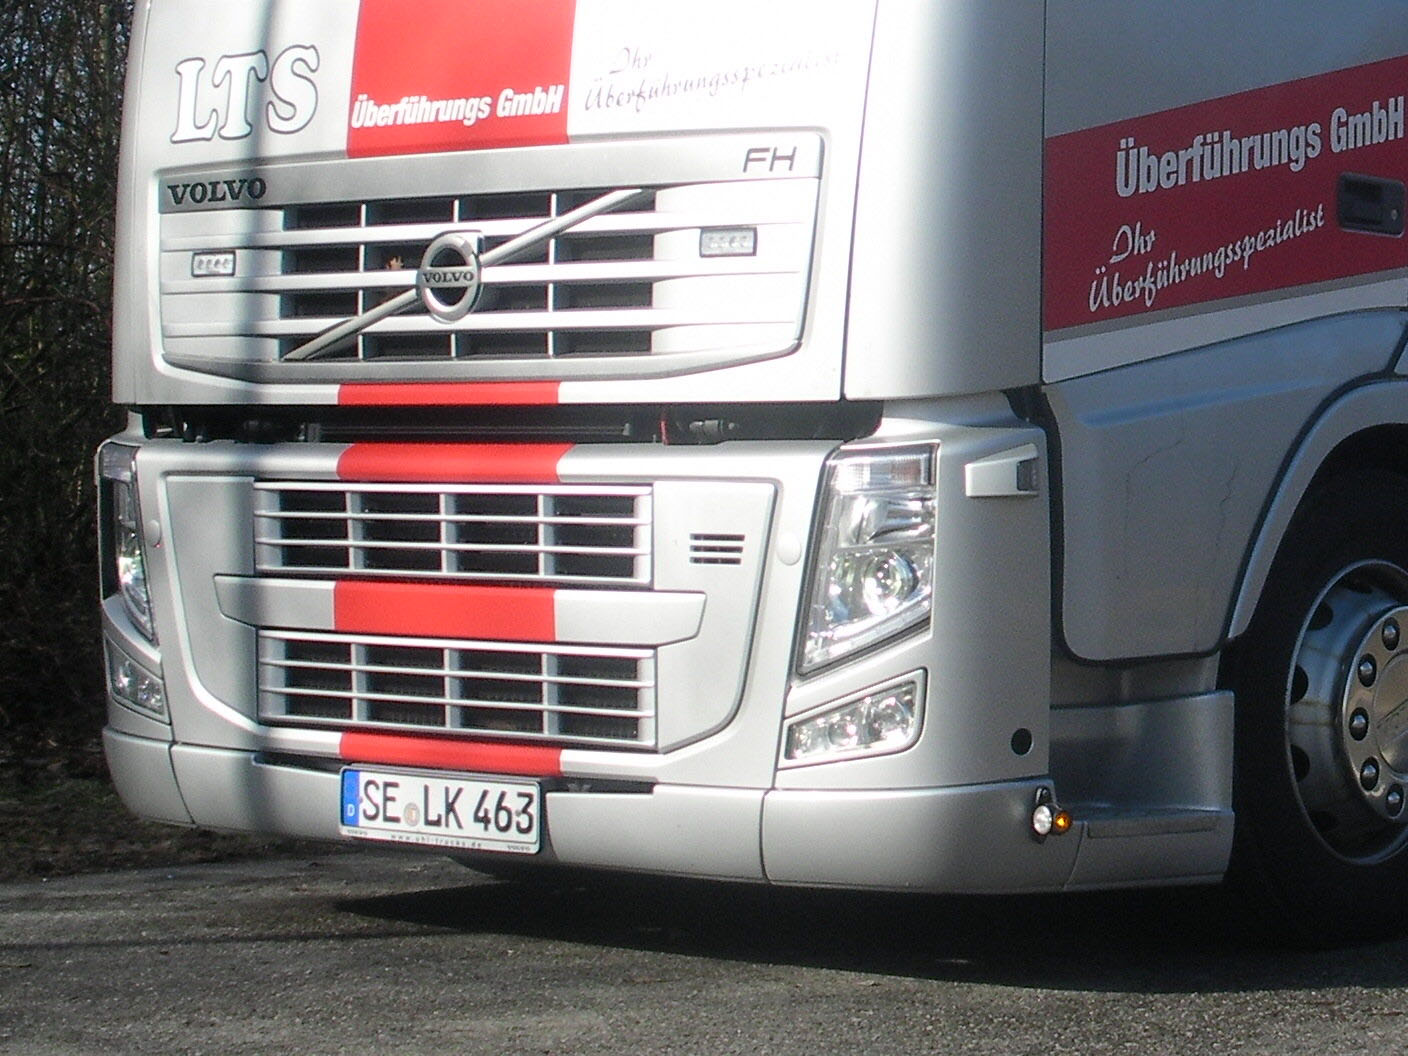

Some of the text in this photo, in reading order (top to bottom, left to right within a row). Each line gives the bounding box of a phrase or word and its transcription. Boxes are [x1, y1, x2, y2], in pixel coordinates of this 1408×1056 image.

[169, 44, 321, 144] LTS
[351, 83, 565, 130] Überführungs GmbH
[742, 145, 798, 174] FH
[1114, 95, 1406, 199] Überführungs GmbH
[166, 176, 267, 206] VOLVO
[1088, 203, 1326, 313] Überführungsspezialist
[1109, 223, 1157, 265] Ihr
[421, 269, 476, 287] VOLVO
[346, 803, 356, 818] D
[362, 779, 535, 835] SE LK 463
